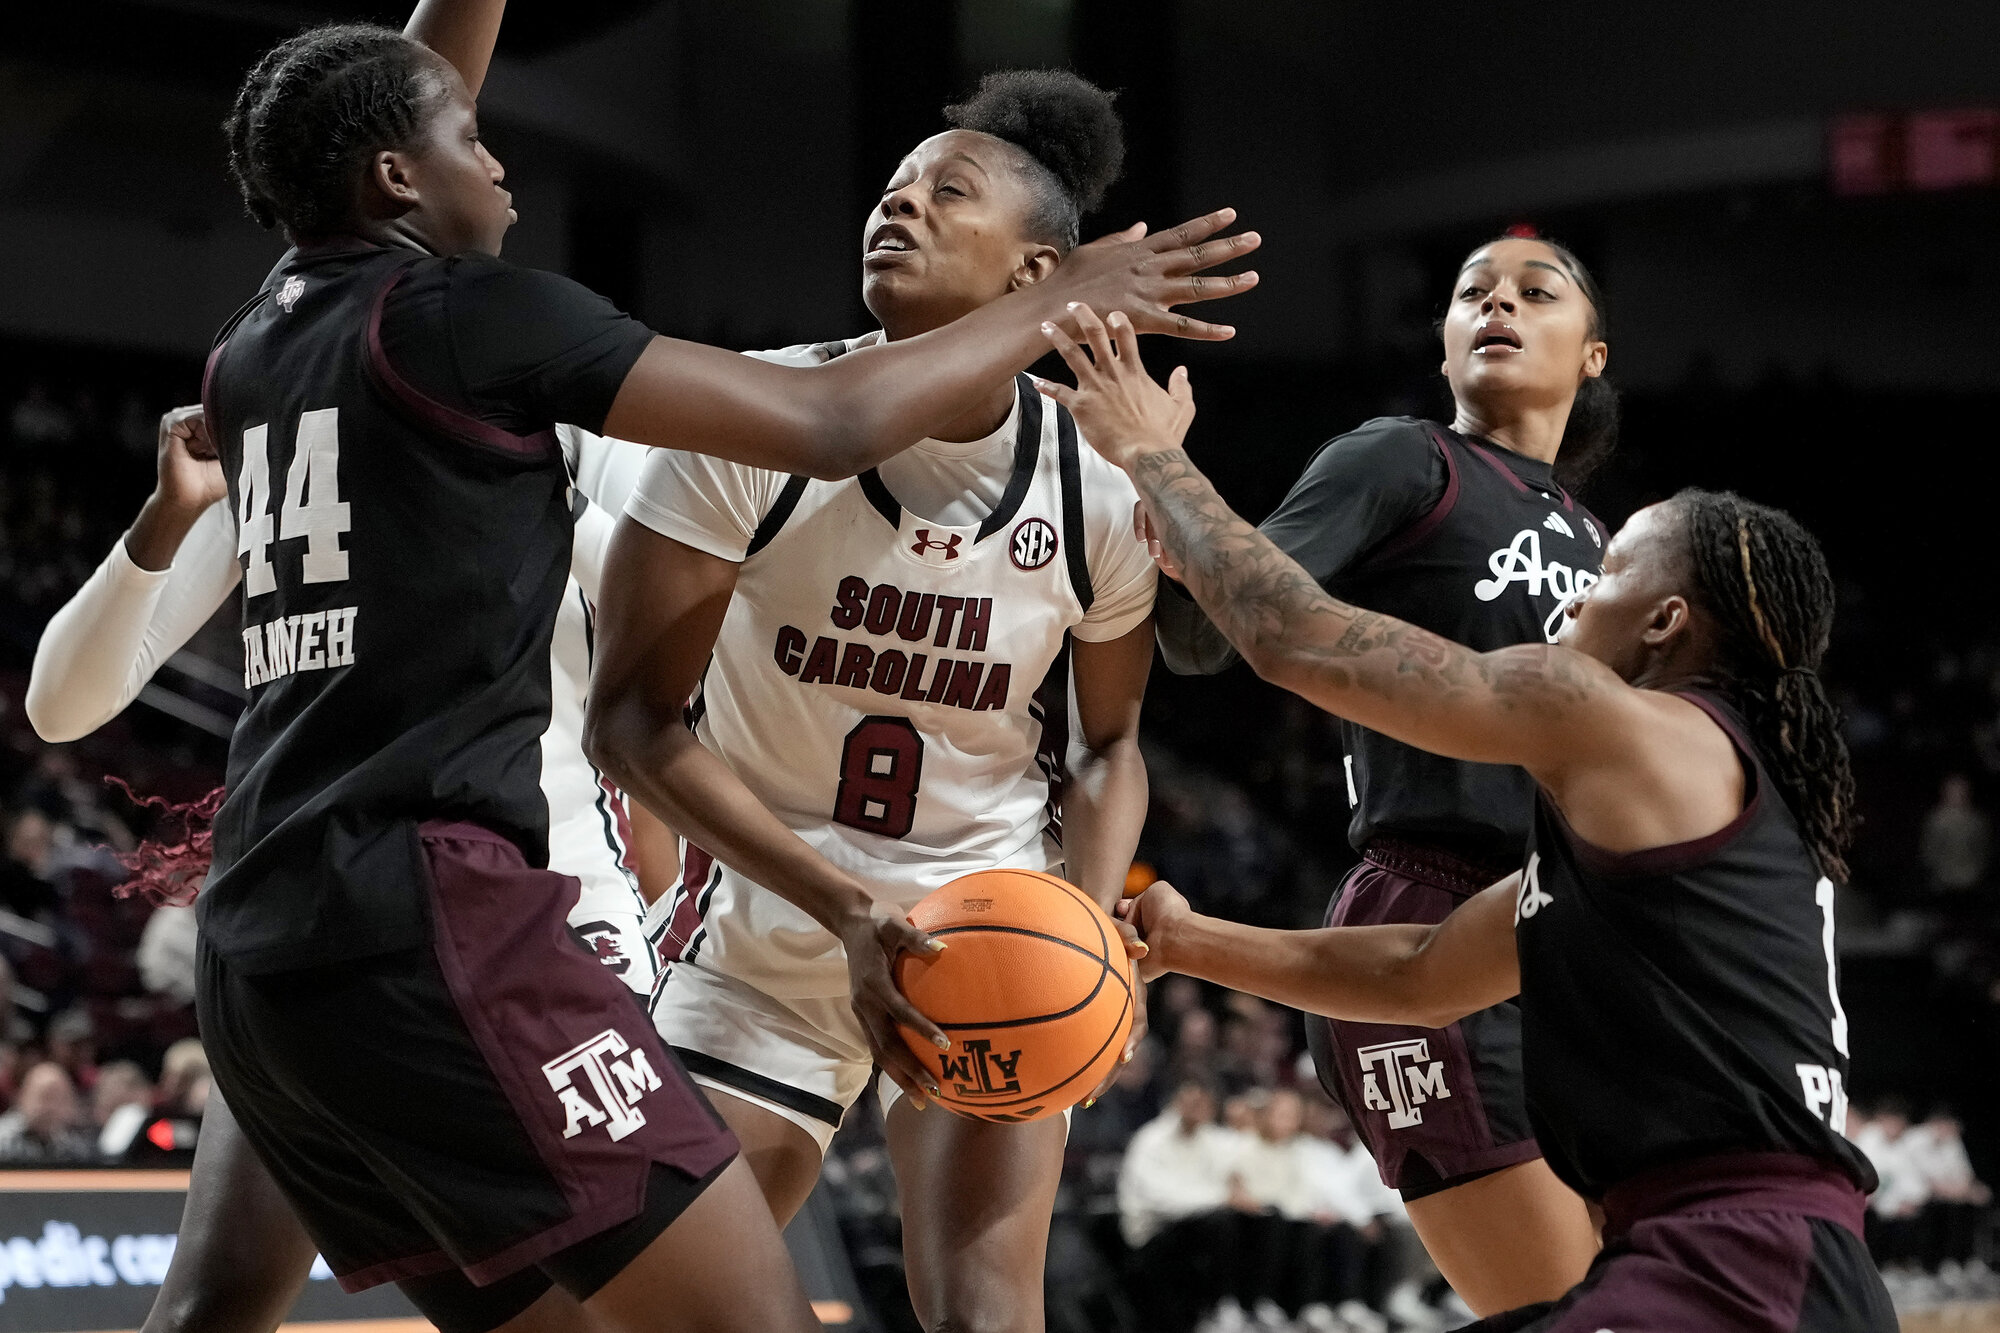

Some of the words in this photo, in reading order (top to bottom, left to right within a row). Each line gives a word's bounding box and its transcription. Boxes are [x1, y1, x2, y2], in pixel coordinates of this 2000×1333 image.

[238, 407, 351, 599] 44
[1014, 521, 1055, 567] SEC
[831, 575, 994, 653] SOUTH
[774, 625, 1012, 712] CAROLINA
[833, 715, 924, 840] 8
